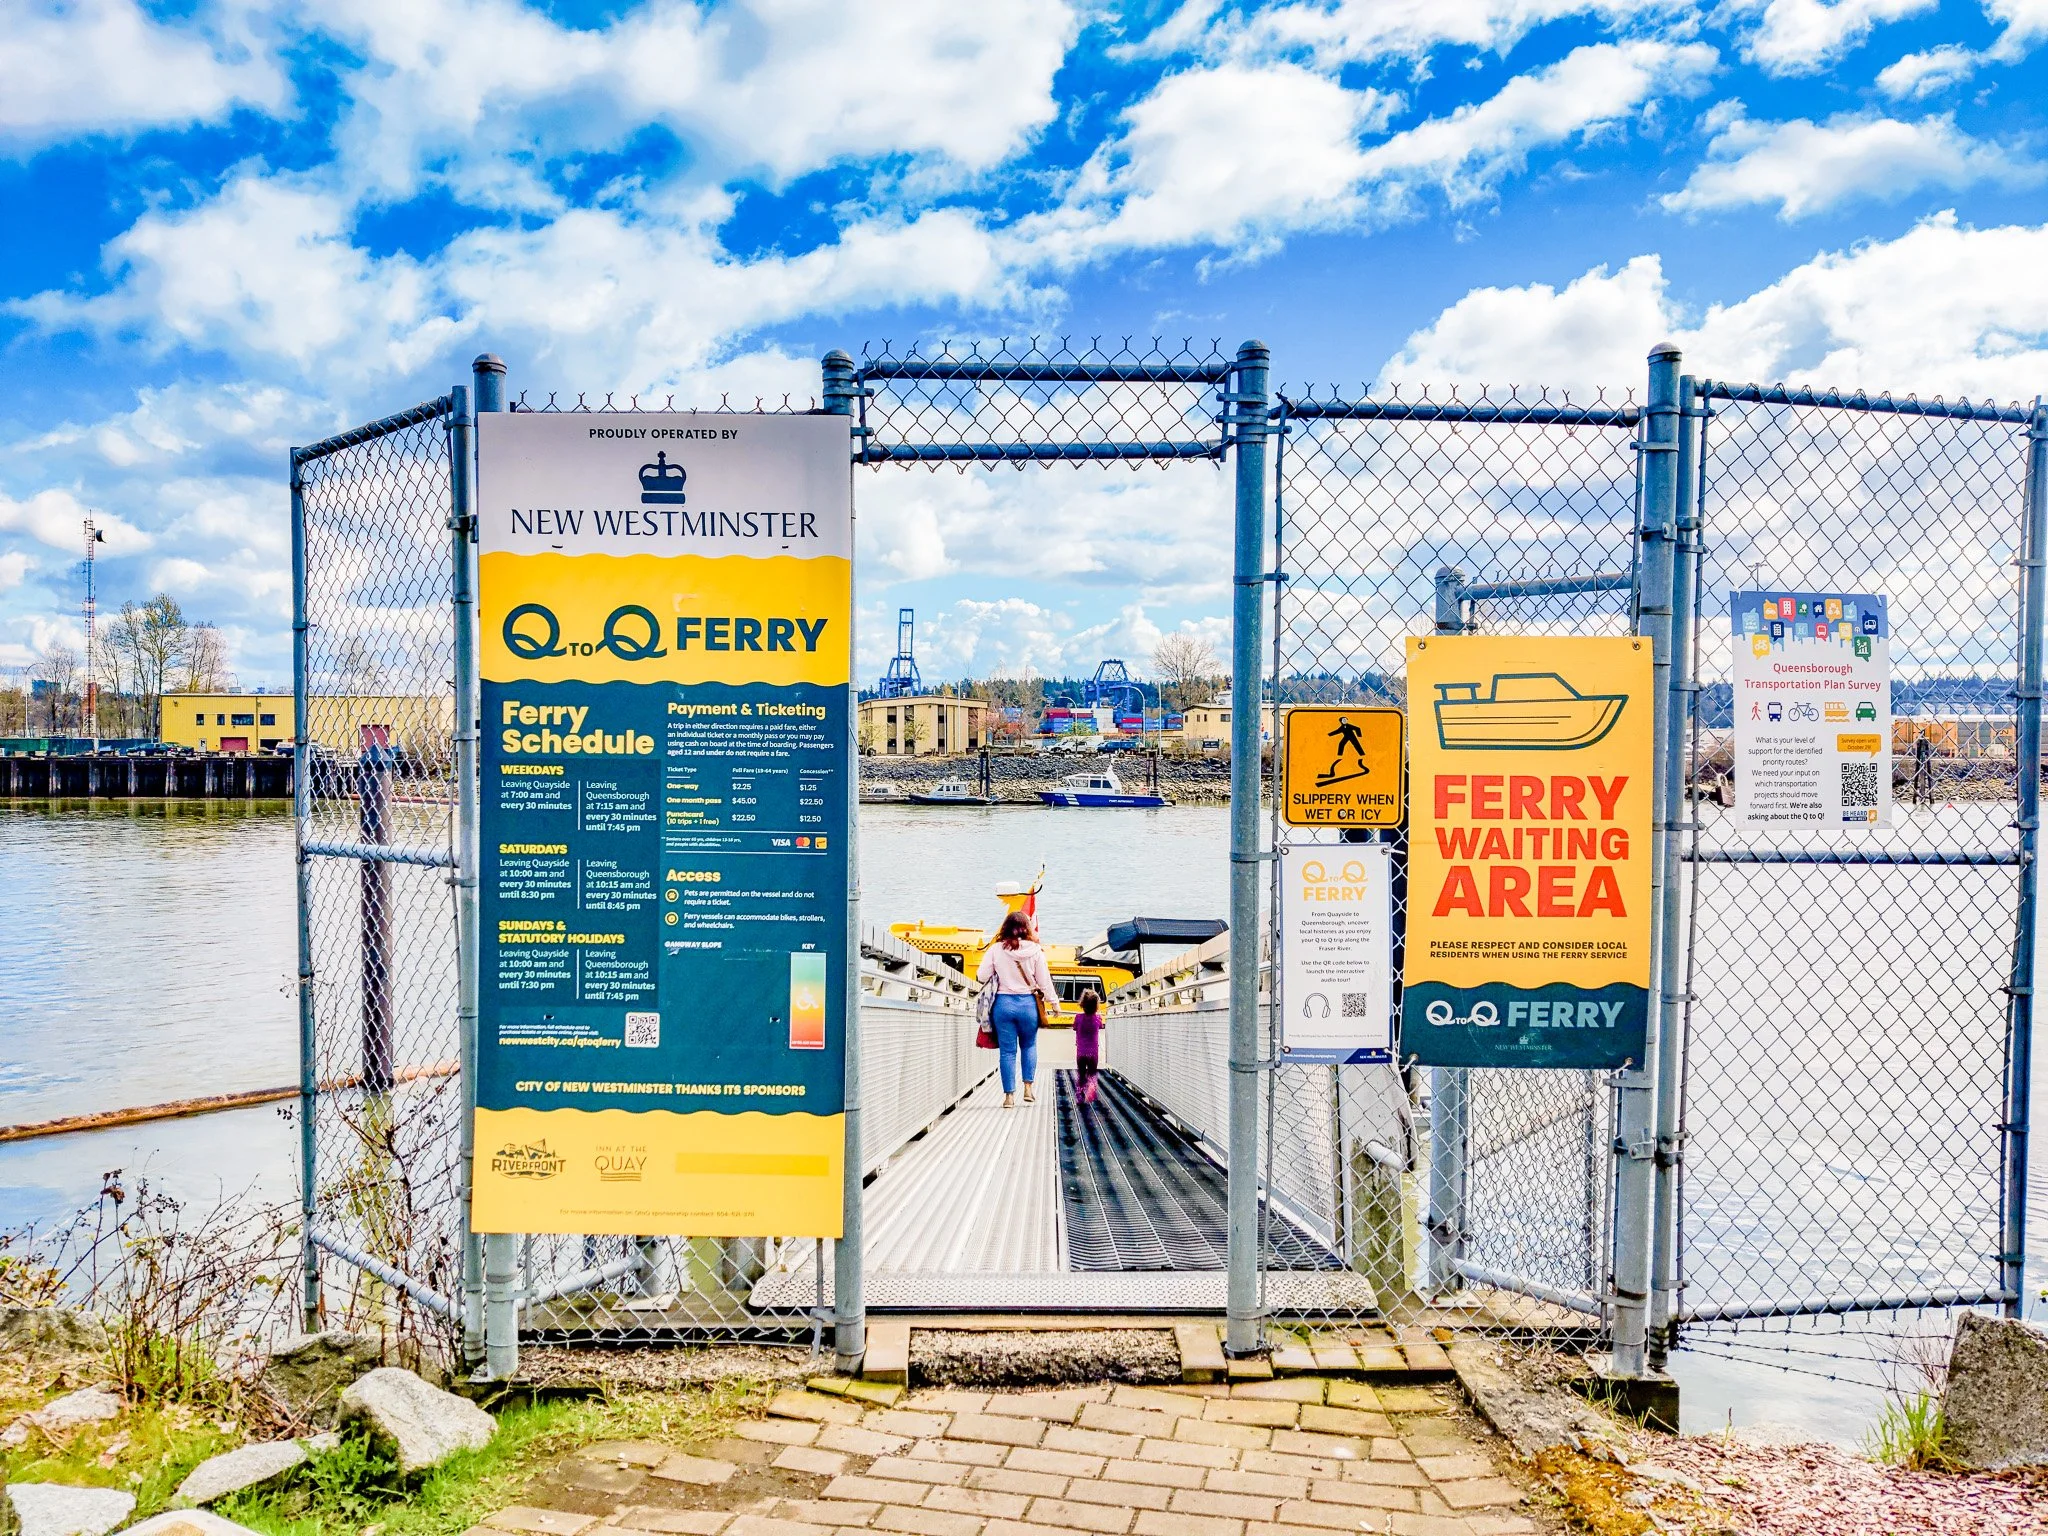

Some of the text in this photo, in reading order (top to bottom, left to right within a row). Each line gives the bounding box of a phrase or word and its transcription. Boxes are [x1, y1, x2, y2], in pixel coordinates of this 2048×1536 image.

[589, 429, 738, 439] PROUDLY OPERATED BY
[511, 509, 818, 538] NEW WESTMINSTER
[503, 603, 828, 661] Q TO Q FERRY
[1773, 663, 1852, 675] Queensborough
[1745, 679, 1881, 692] Transportation Plan Survey
[668, 703, 826, 720] Payment & Ticketing
[502, 701, 589, 733] Ferry
[502, 729, 654, 754] Schedule
[501, 765, 564, 775] WEEKDAYS
[1795, 770, 1810, 778] input
[501, 781, 570, 790] Leaving Quayside
[586, 781, 617, 790] Leaving
[586, 792, 649, 801] Queensborough
[1293, 794, 1394, 804] SLIPPERY WHEN
[1434, 775, 1630, 820] FERRY
[630, 802, 645, 810] and
[800, 798, 823, 806] $22.50
[611, 813, 621, 821] 30
[623, 813, 657, 821] minutes
[732, 814, 755, 822] $22.50
[1305, 809, 1332, 819] WET
[1362, 809, 1381, 820] ICY
[1748, 813, 1769, 821] asking
[1435, 827, 1630, 860] WAITING
[500, 844, 567, 854] SATURDAYS
[500, 859, 569, 868] Leaving Quayside
[586, 860, 617, 868] Leaving
[586, 870, 649, 879] Queensborough
[666, 869, 721, 882] Access
[1302, 861, 1328, 883] Q
[1340, 861, 1368, 883] Q
[635, 881, 650, 889] and
[623, 892, 657, 900] minutes
[1304, 887, 1367, 901] FERRY
[1432, 866, 1628, 917] AREA
[607, 902, 625, 910] 8:45
[499, 921, 566, 930] SUNDAYS &
[499, 934, 625, 943] STATUTORY HOLIDAYS
[1430, 941, 1468, 949] PLEASE
[1471, 941, 1516, 949] RESPECT
[1542, 942, 1593, 950] CONSIDER
[1597, 942, 1627, 950] LOCAL
[1426, 1000, 1455, 1026] Q
[1467, 1001, 1500, 1027] Q
[1507, 1001, 1624, 1027] FERRY
[516, 1081, 806, 1096] CITY OF NEW WESTMINSTER THANKS ITS SPONSORS
[492, 1159, 566, 1172] RIVERFRONT
[595, 1156, 647, 1173] QUAY
